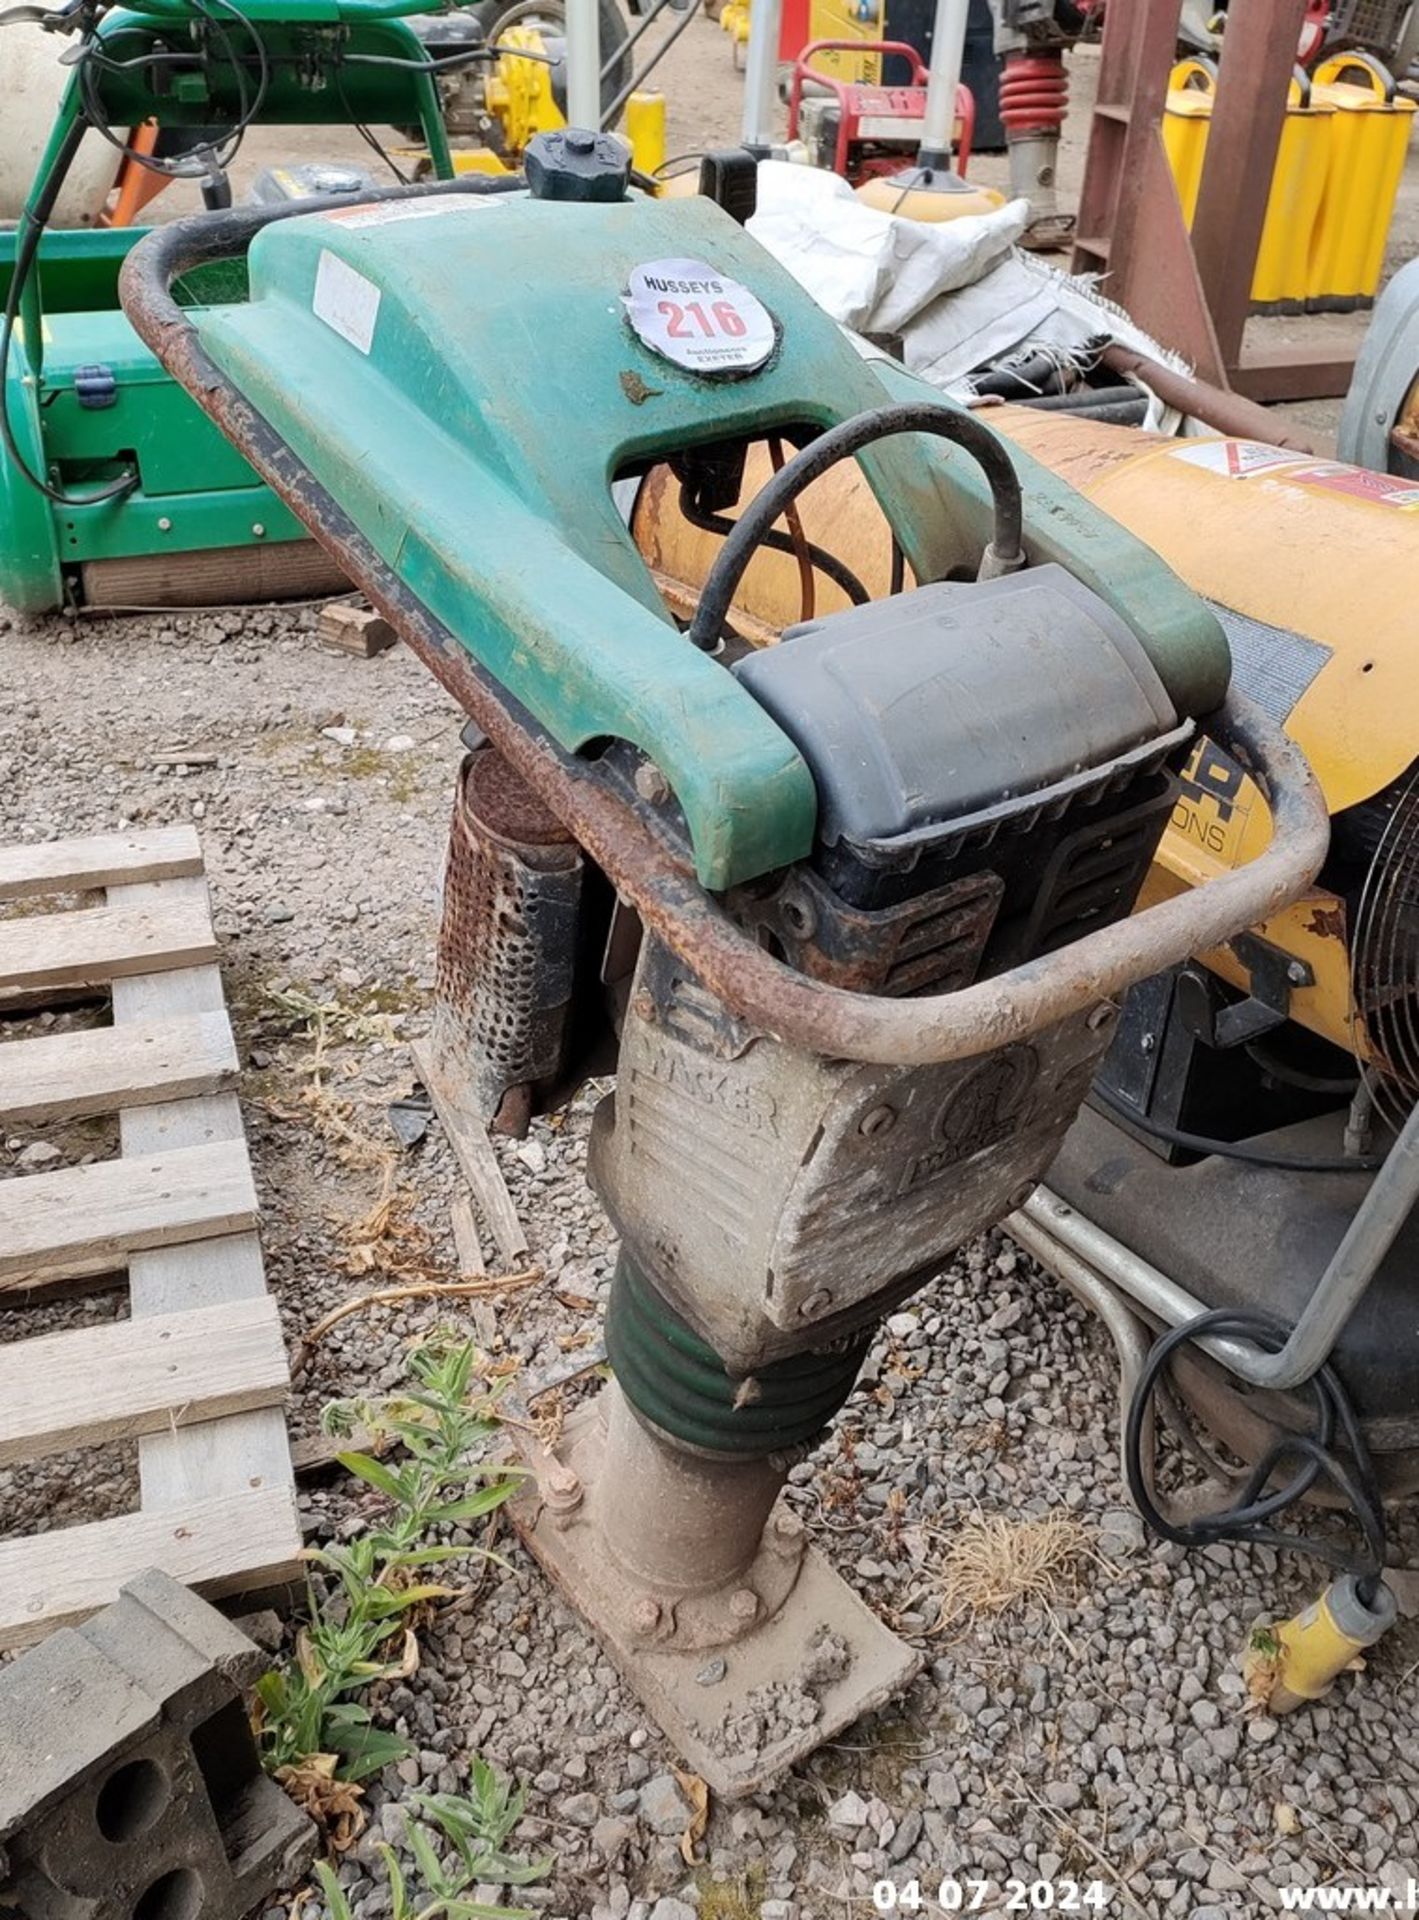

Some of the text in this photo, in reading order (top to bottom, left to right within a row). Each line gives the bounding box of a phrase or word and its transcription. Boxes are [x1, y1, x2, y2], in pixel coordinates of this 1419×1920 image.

[643, 275, 724, 295] HUSSEYS
[657, 300, 748, 339] 216
[697, 353, 744, 363] EXETER
